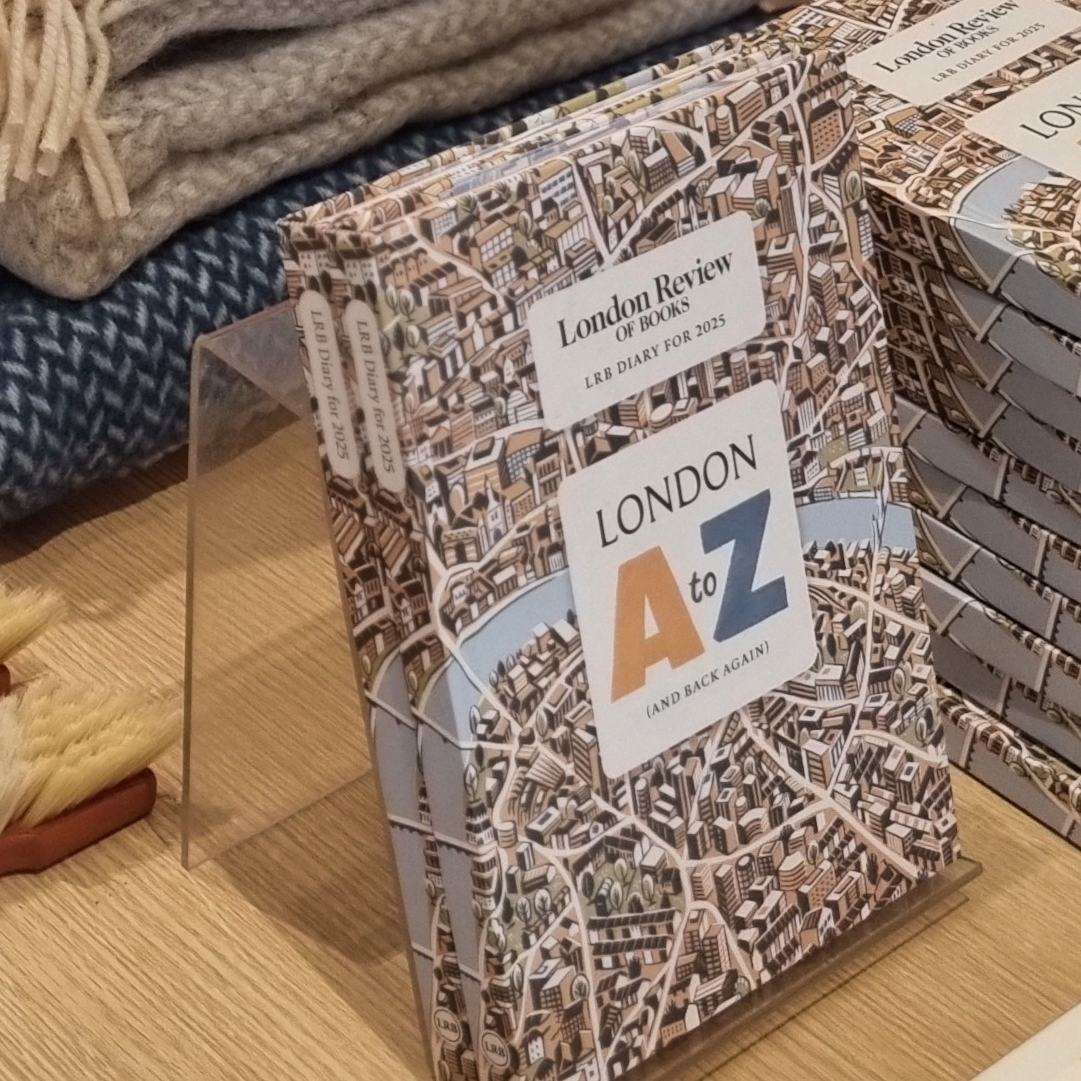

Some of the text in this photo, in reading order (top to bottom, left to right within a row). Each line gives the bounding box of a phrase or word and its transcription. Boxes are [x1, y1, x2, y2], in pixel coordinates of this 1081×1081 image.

[873, 0, 1019, 73] London Review
[930, 22, 1046, 83] LRB DIARY FOR 2025
[936, 26, 1000, 59] OF BOOKS
[557, 252, 733, 348] London Review
[615, 296, 690, 342] OF BOOKS
[310, 310, 348, 460] LRB Diary for 2025
[583, 313, 727, 390] LRB DIARY FOR 2025
[356, 320, 394, 474] LRB Diary for 2025
[596, 434, 757, 548] LONDON
[610, 488, 789, 704] A to Z
[646, 640, 770, 719] (AND BACK AGAIN)
[437, 1017, 458, 1034] LRB
[485, 1041, 506, 1058] LRB
